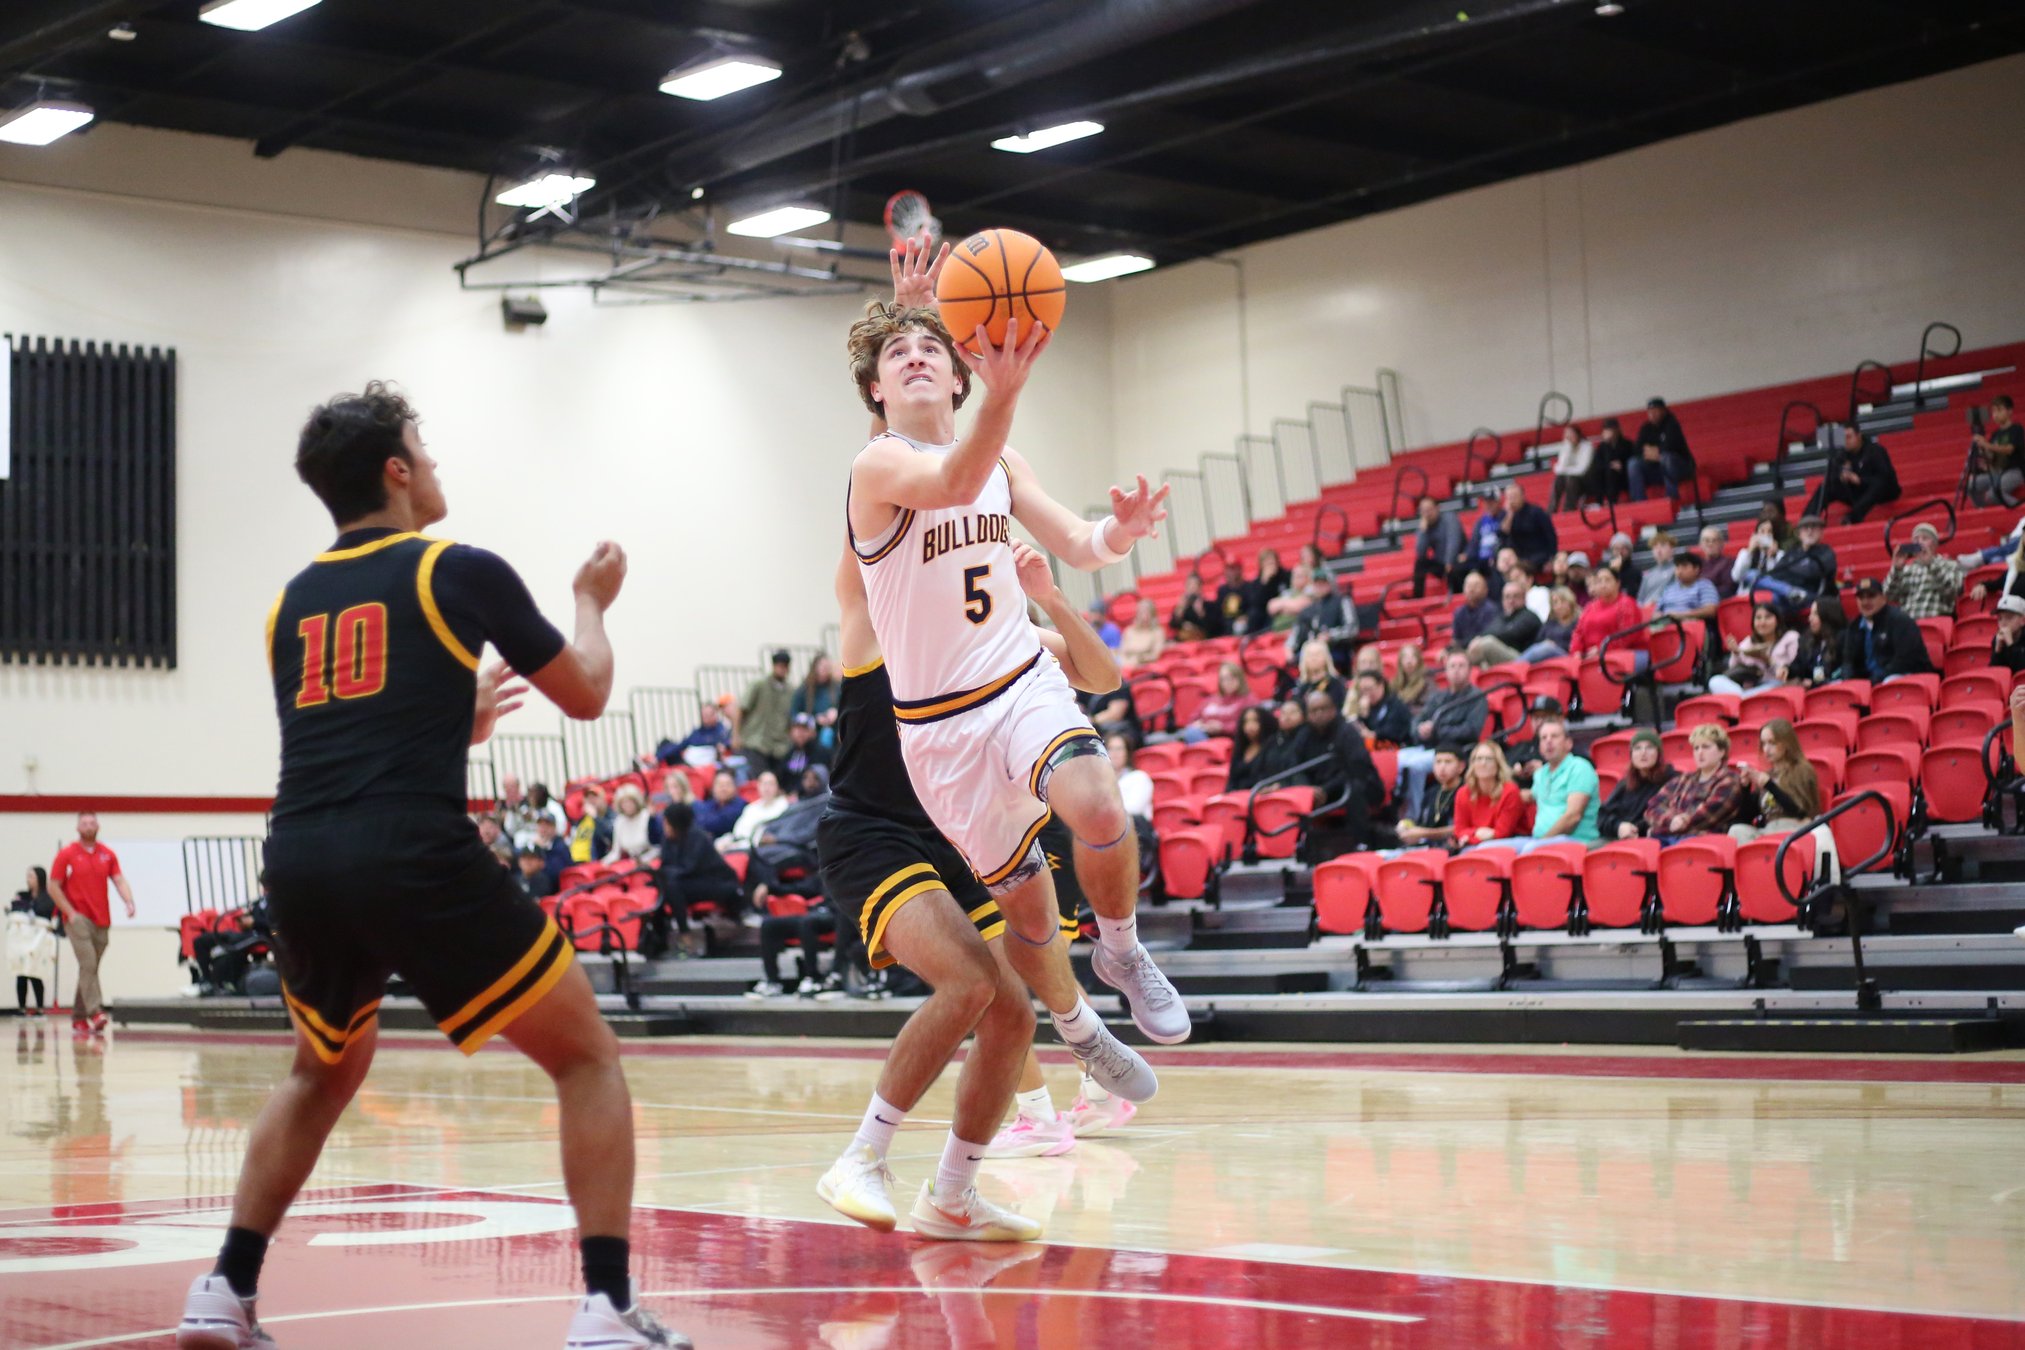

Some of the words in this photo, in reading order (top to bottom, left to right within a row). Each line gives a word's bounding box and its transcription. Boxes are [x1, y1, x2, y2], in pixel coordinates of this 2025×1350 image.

[922, 513, 1010, 565] BULLDOG
[963, 563, 993, 627] 5
[295, 601, 388, 709] 10
